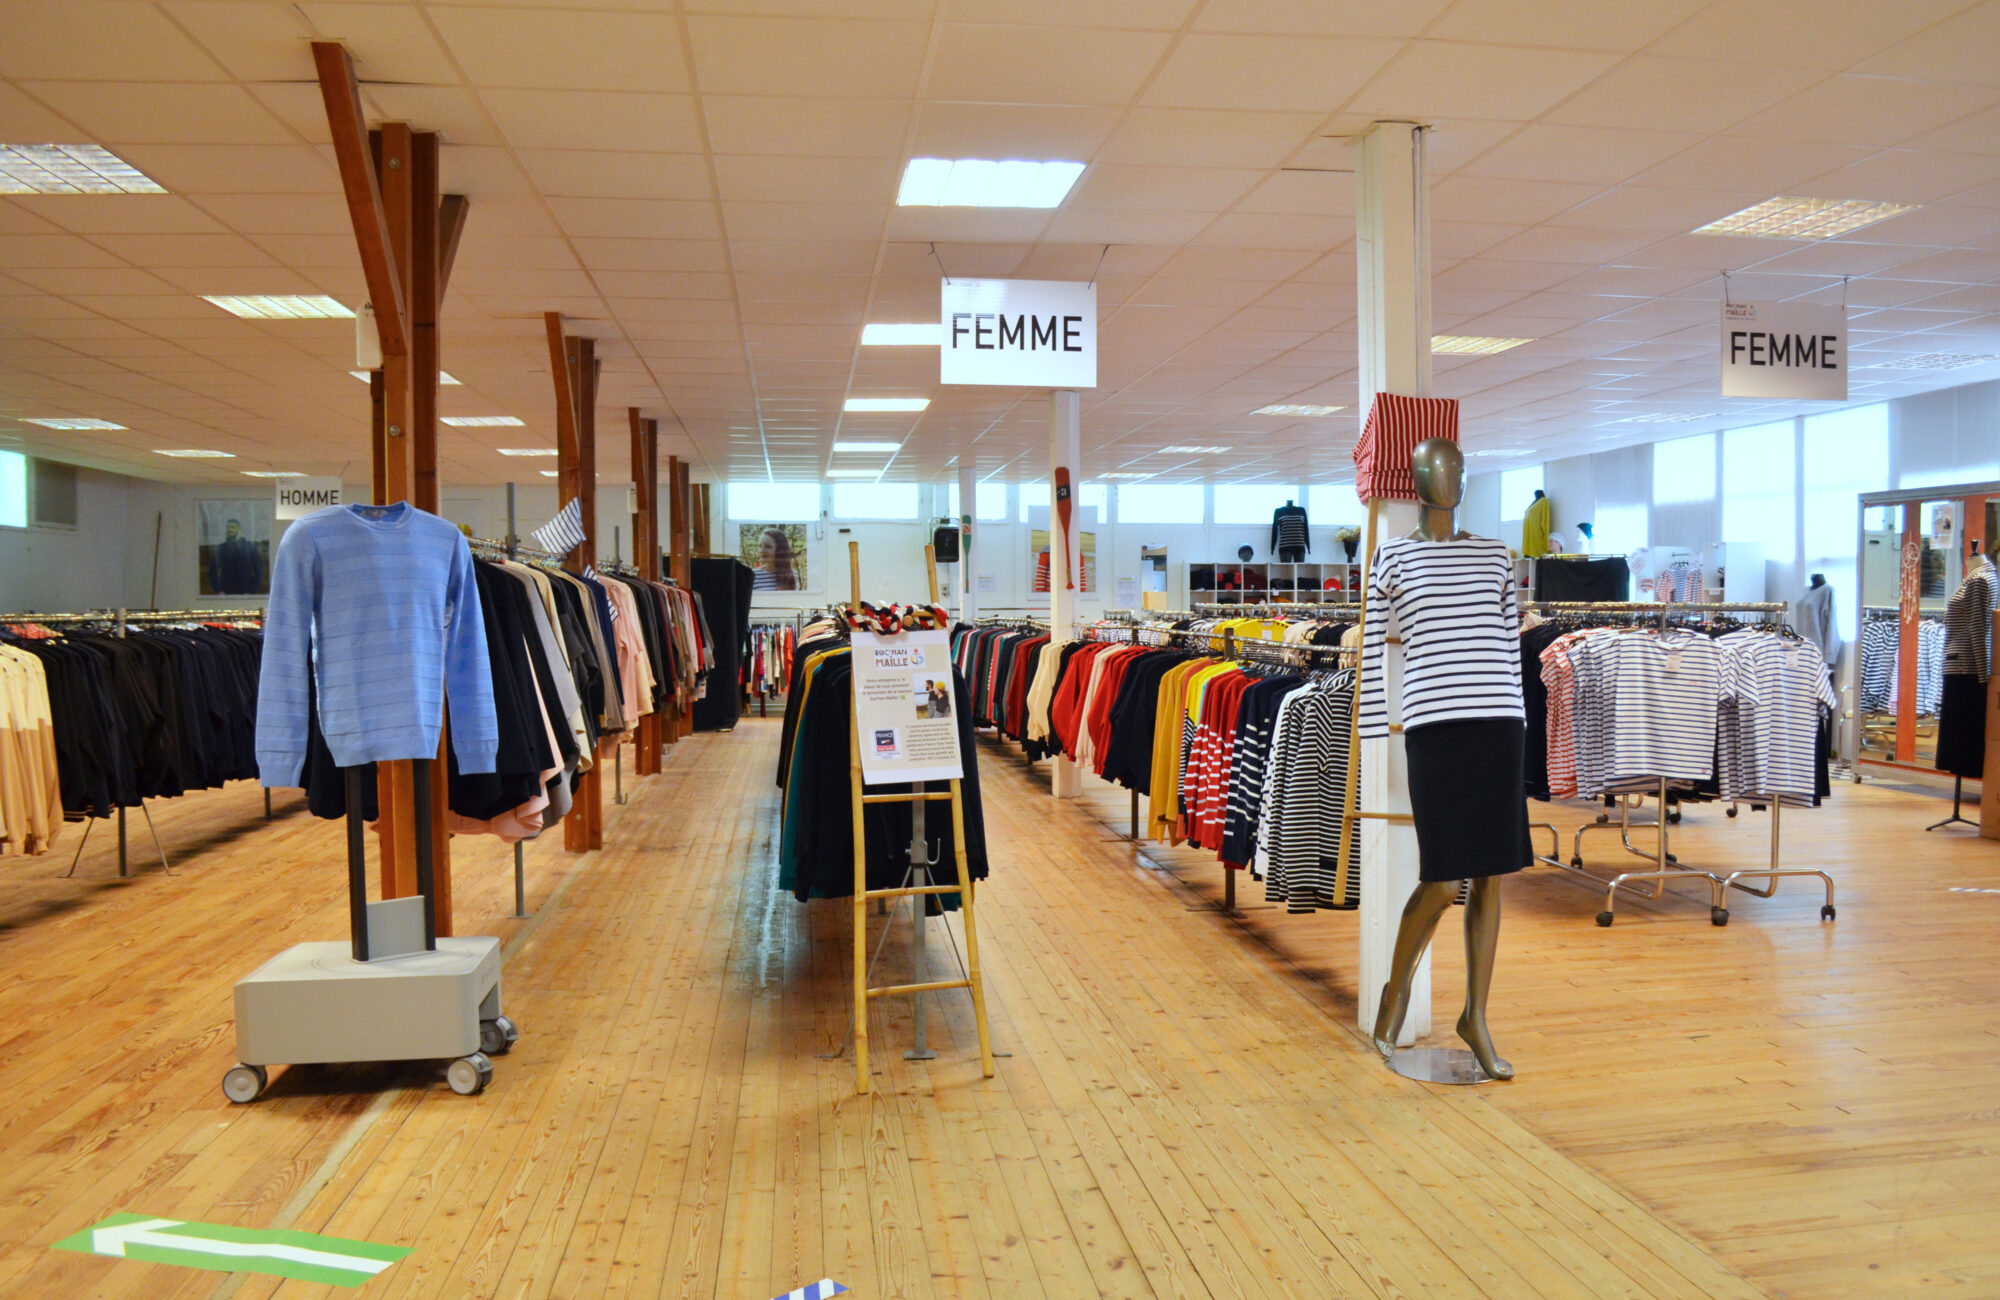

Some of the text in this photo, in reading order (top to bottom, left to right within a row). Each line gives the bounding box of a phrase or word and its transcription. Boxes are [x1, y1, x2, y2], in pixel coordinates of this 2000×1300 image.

[953, 313, 1082, 352] FEMME
[1731, 331, 1837, 369] FEMME
[280, 490, 339, 505] HOMME
